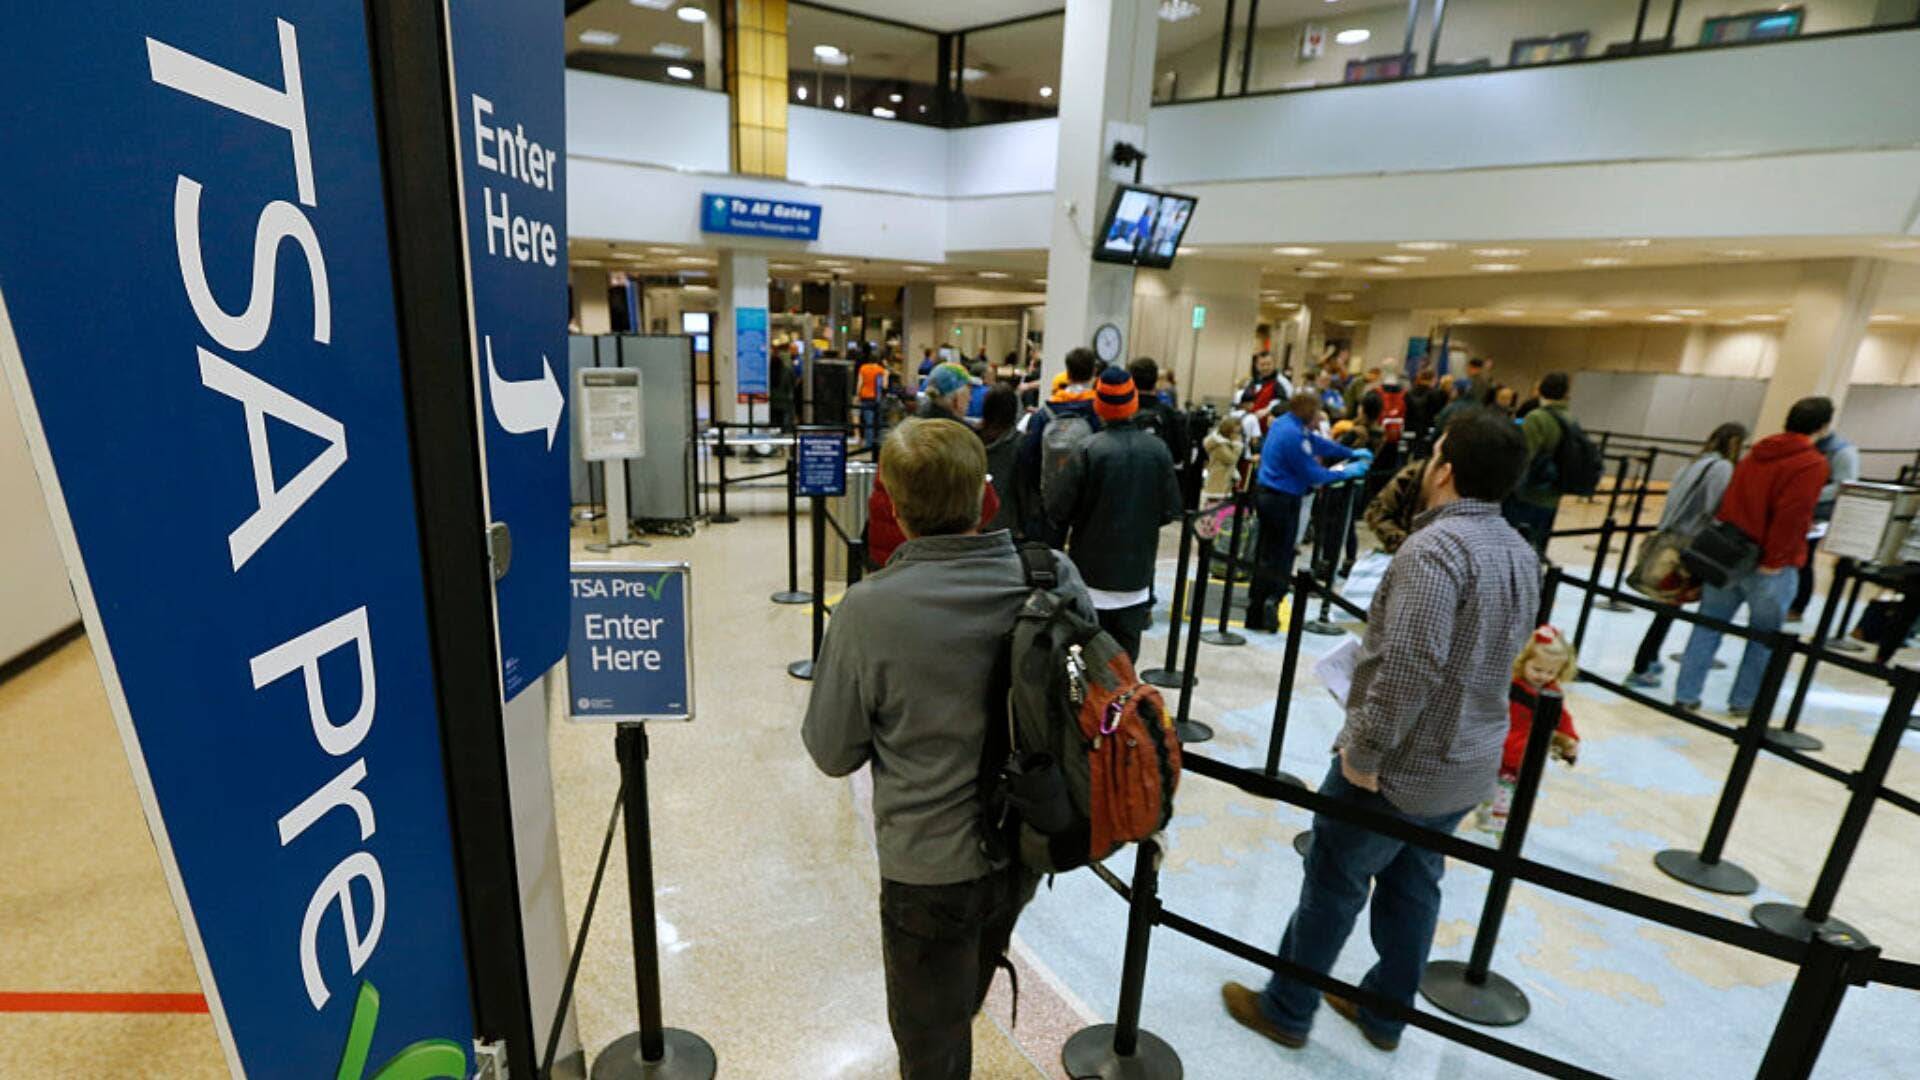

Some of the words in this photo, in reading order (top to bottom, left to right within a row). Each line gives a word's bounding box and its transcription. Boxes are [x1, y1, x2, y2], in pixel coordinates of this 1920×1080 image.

[472, 93, 556, 192] Enter
[731, 199, 748, 214] To
[751, 202, 771, 216] All
[773, 203, 811, 220] Gates
[484, 187, 557, 267] Here
[146, 18, 348, 573] TSA
[250, 606, 385, 1010] Pre
[570, 578, 608, 598] TSA
[612, 578, 646, 598] Pre
[585, 614, 664, 640] Enter
[592, 645, 661, 671] Here
